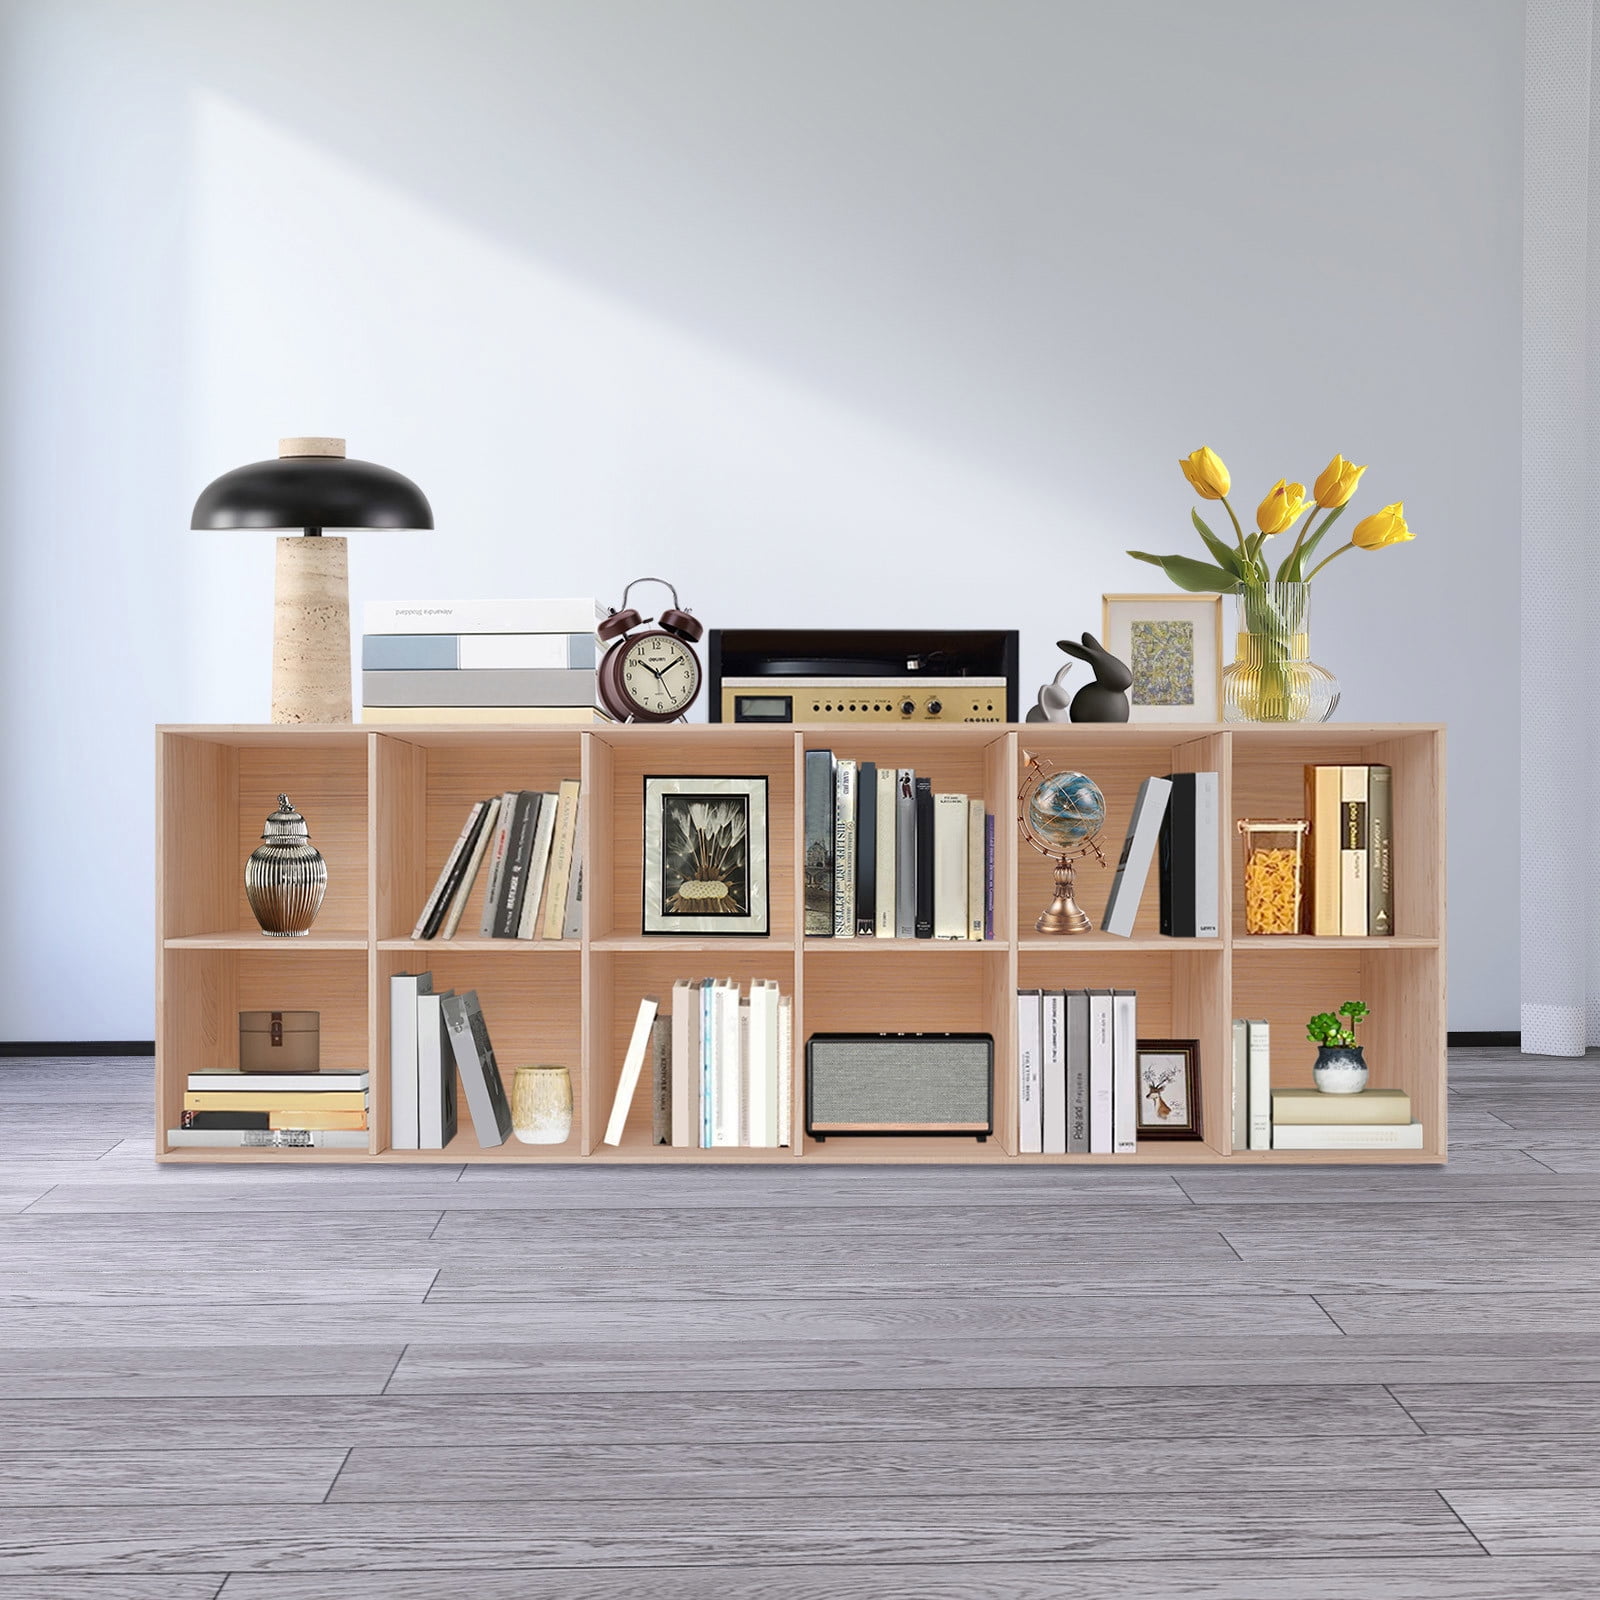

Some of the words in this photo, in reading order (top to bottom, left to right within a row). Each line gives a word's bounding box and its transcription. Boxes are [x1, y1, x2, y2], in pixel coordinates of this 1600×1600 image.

[652, 641, 661, 650] 12
[638, 647, 645, 655] 11
[670, 646, 675, 655] 1
[629, 659, 637, 667] 10
[626, 672, 632, 681] 9
[684, 671, 690, 679] 3
[631, 687, 637, 695] 8
[681, 686, 686, 694] 4
[643, 697, 649, 705] 7
[671, 696, 677, 704] 5
[657, 702, 663, 710] 6
